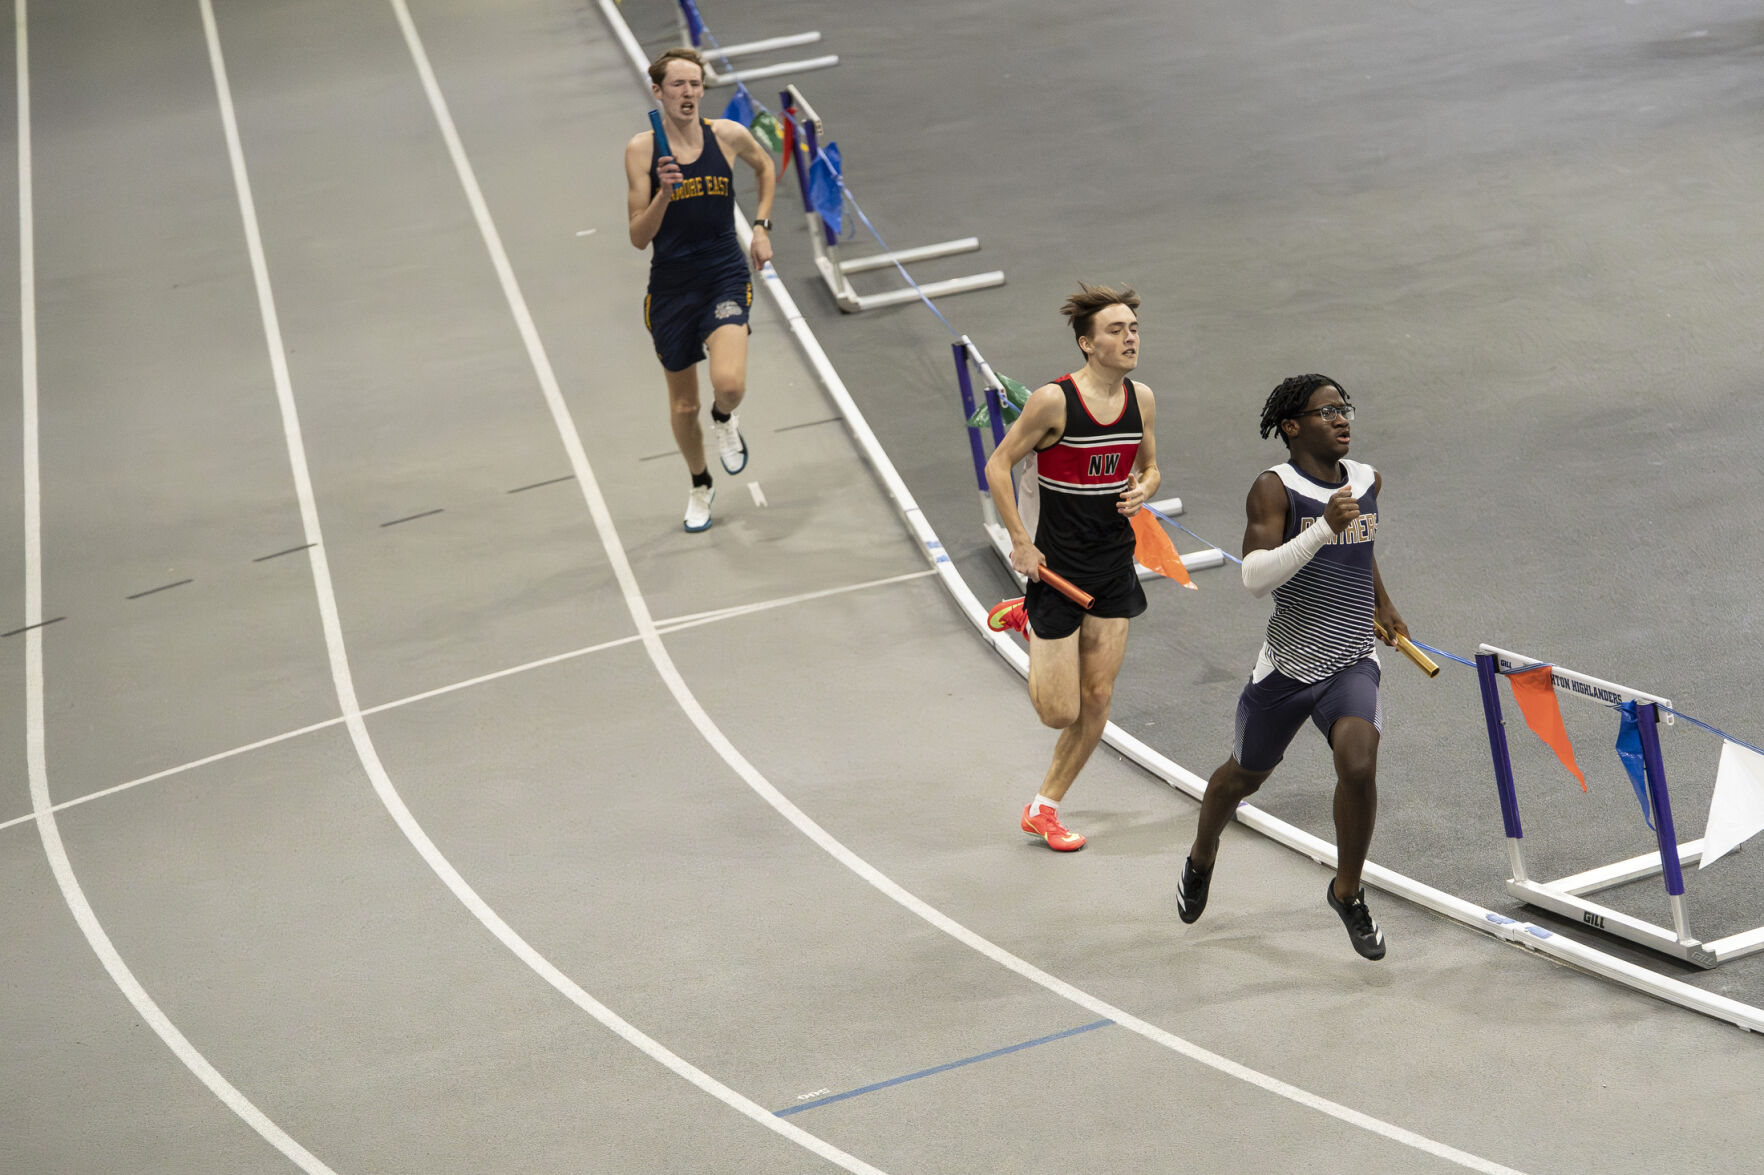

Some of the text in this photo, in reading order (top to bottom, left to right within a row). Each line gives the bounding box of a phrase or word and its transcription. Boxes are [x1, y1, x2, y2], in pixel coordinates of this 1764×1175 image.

[704, 175, 729, 197] EAST
[1088, 452, 1121, 477] NW
[1572, 679, 1623, 705] HIGHLANDERS
[1583, 910, 1605, 929] GILL
